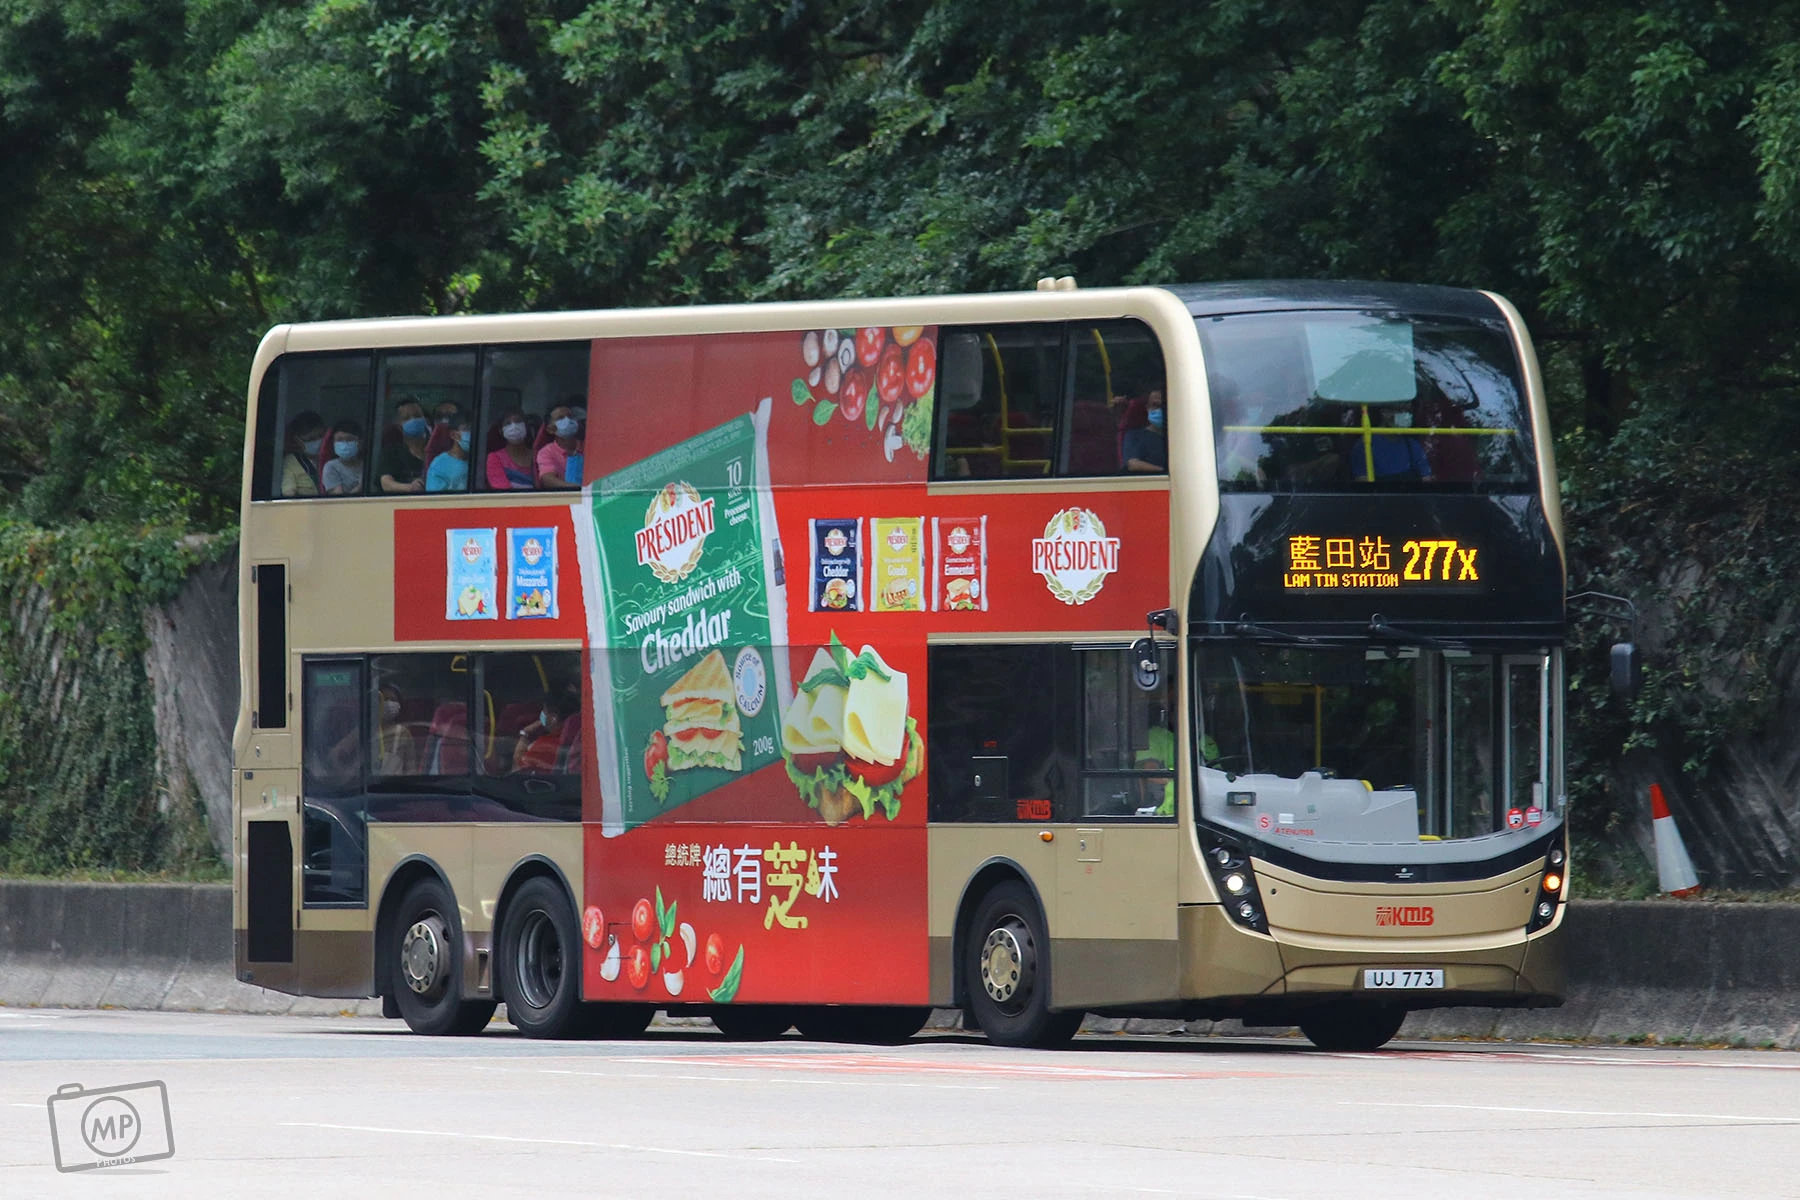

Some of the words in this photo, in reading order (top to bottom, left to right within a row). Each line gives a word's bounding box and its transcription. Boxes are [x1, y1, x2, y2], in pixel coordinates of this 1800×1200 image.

[726, 461, 742, 488] 10
[636, 500, 714, 563] PRÉSIDENT
[1034, 535, 1118, 577] PRÉSIDENT
[1288, 535, 1391, 571] 藍田站
[823, 565, 849, 577] Cheddar
[1284, 573, 1311, 588] LAM
[1314, 573, 1339, 588] TIN
[1341, 573, 1399, 588] STATION
[625, 604, 667, 635] Savoury
[668, 577, 716, 616] sandwich
[716, 566, 741, 593] with
[641, 608, 731, 674] Cheddar
[739, 684, 764, 712] CALCIUM
[752, 735, 774, 756] 200g
[664, 842, 702, 867] 總統牌
[702, 841, 839, 930] 總有芝味
[1392, 906, 1434, 927] KMB
[1373, 971, 1395, 987] UJ
[1402, 971, 1434, 987] 773
